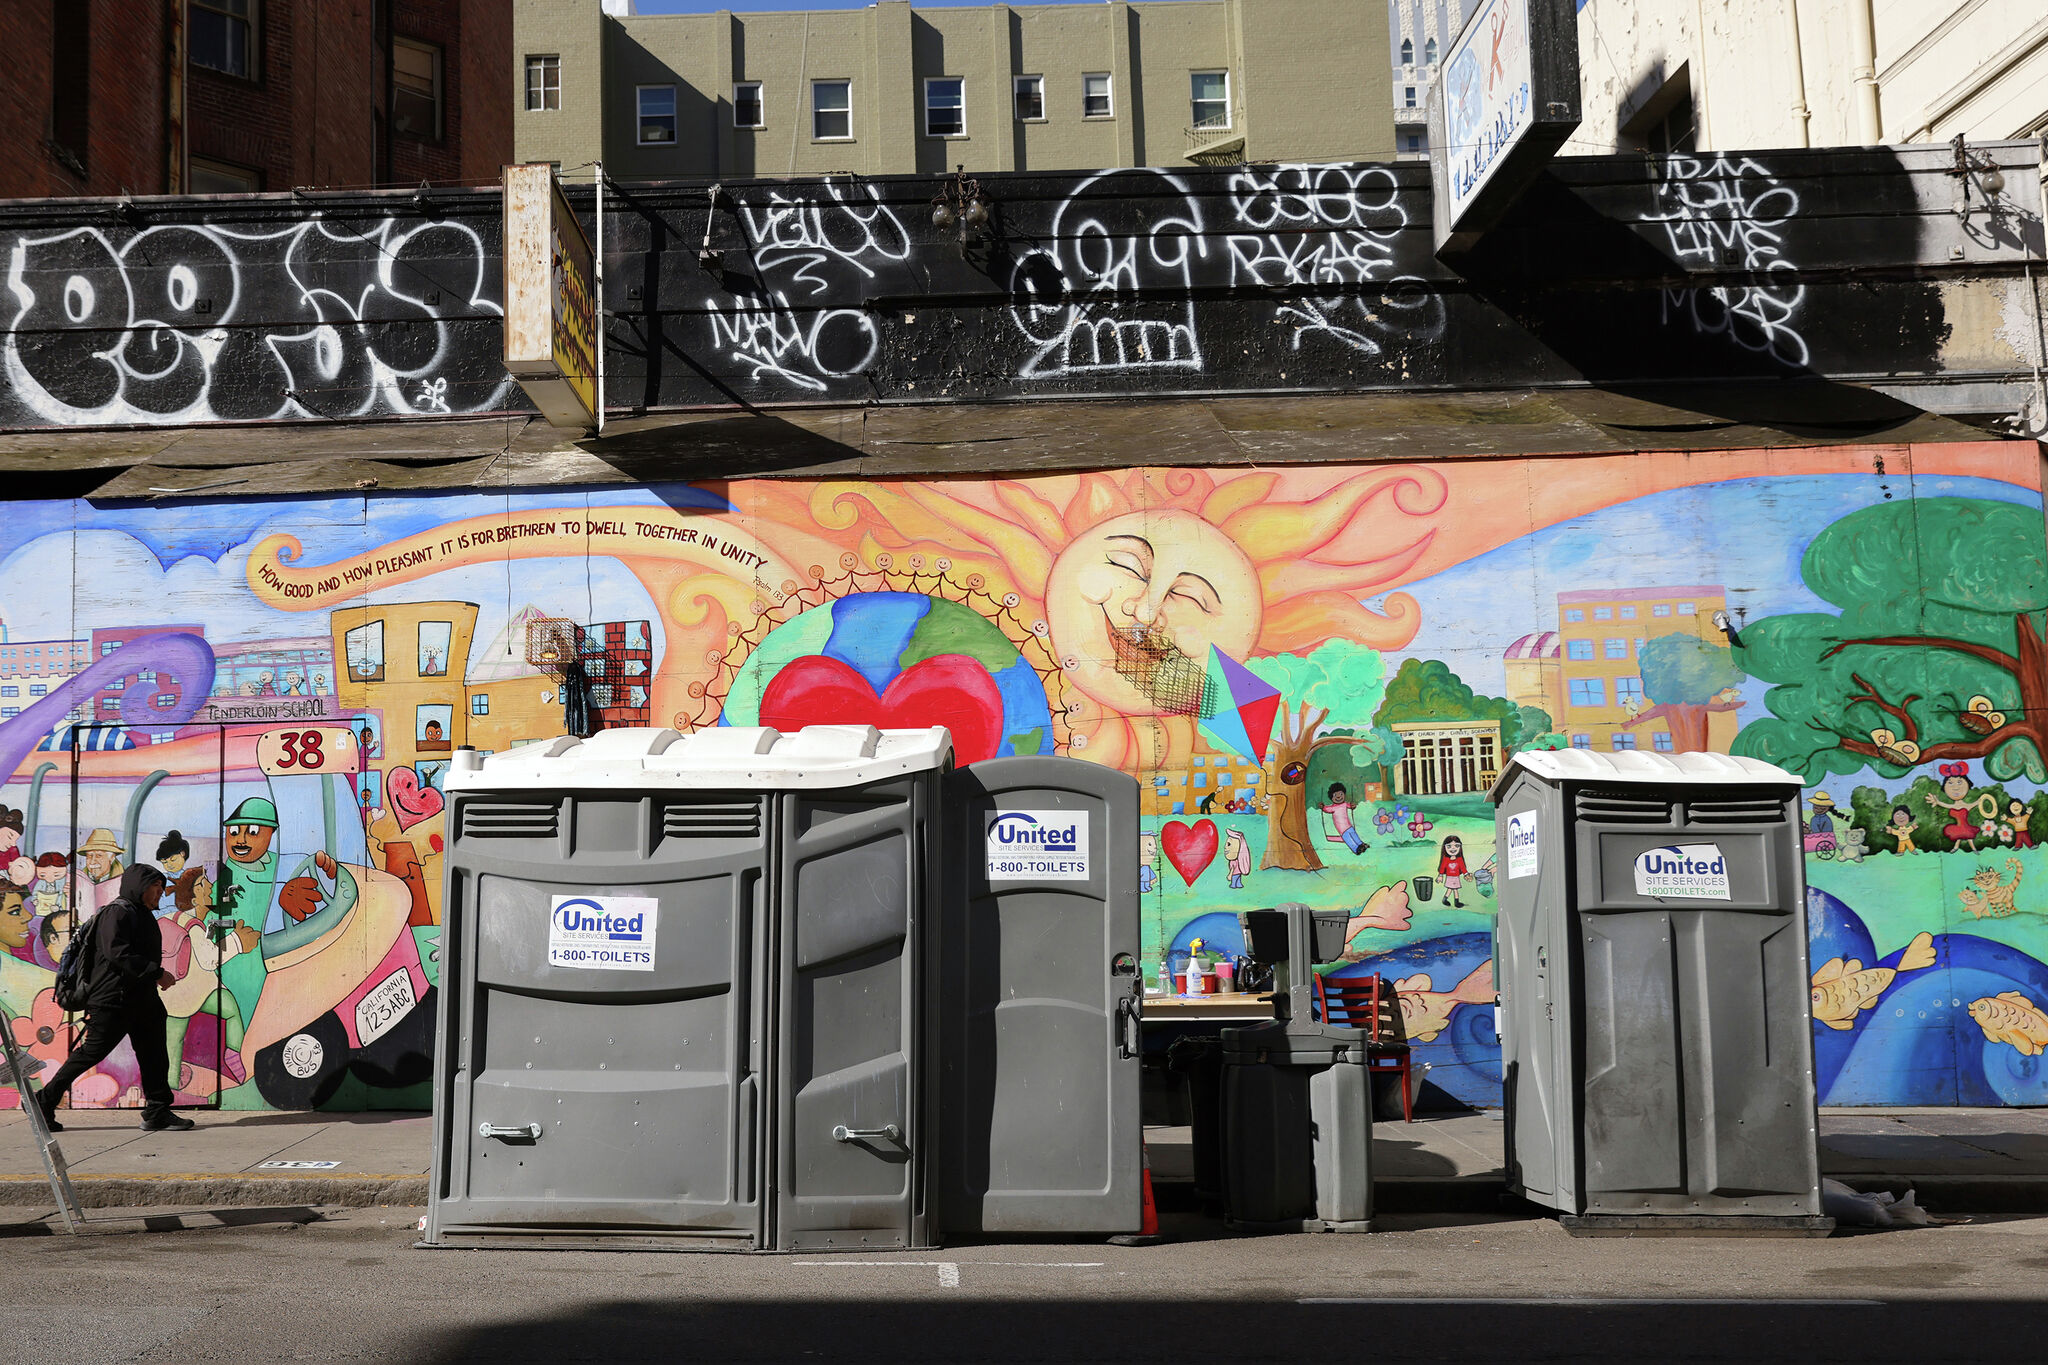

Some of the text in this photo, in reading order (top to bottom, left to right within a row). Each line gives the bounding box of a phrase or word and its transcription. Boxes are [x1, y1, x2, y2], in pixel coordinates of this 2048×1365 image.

[258, 563, 285, 592] HOW
[284, 583, 314, 598] GOOD
[317, 576, 341, 595] AND
[342, 562, 373, 585] HOW
[376, 546, 433, 575] PLEASANT
[440, 539, 453, 555] IT
[457, 534, 470, 550] IS
[471, 529, 496, 546] FOR
[496, 522, 556, 542] BRETHREN
[561, 521, 581, 534] TO
[635, 522, 698, 544] TOGETHER
[701, 534, 718, 550] IN
[720, 541, 769, 570] UNITY
[753, 575, 784, 601] Psalm 133
[204, 698, 328, 720] TENDERLOIN SCHOOL
[276, 730, 325, 769] 38
[998, 824, 1076, 844] United
[1510, 825, 1535, 848] United
[988, 861, 1086, 873] 1-800-TOILETS
[1644, 854, 1724, 875] United
[1645, 877, 1726, 886] SITE SERVICES
[1647, 887, 1726, 896] 1800TOILETS.com
[563, 910, 644, 933] United
[562, 932, 609, 940] SITE SERVICES
[551, 949, 651, 963] 1-800-TOILETS
[361, 975, 407, 1015] CALIFORNIA
[366, 988, 411, 1033] 123ABC
[297, 1061, 317, 1076] BUS
